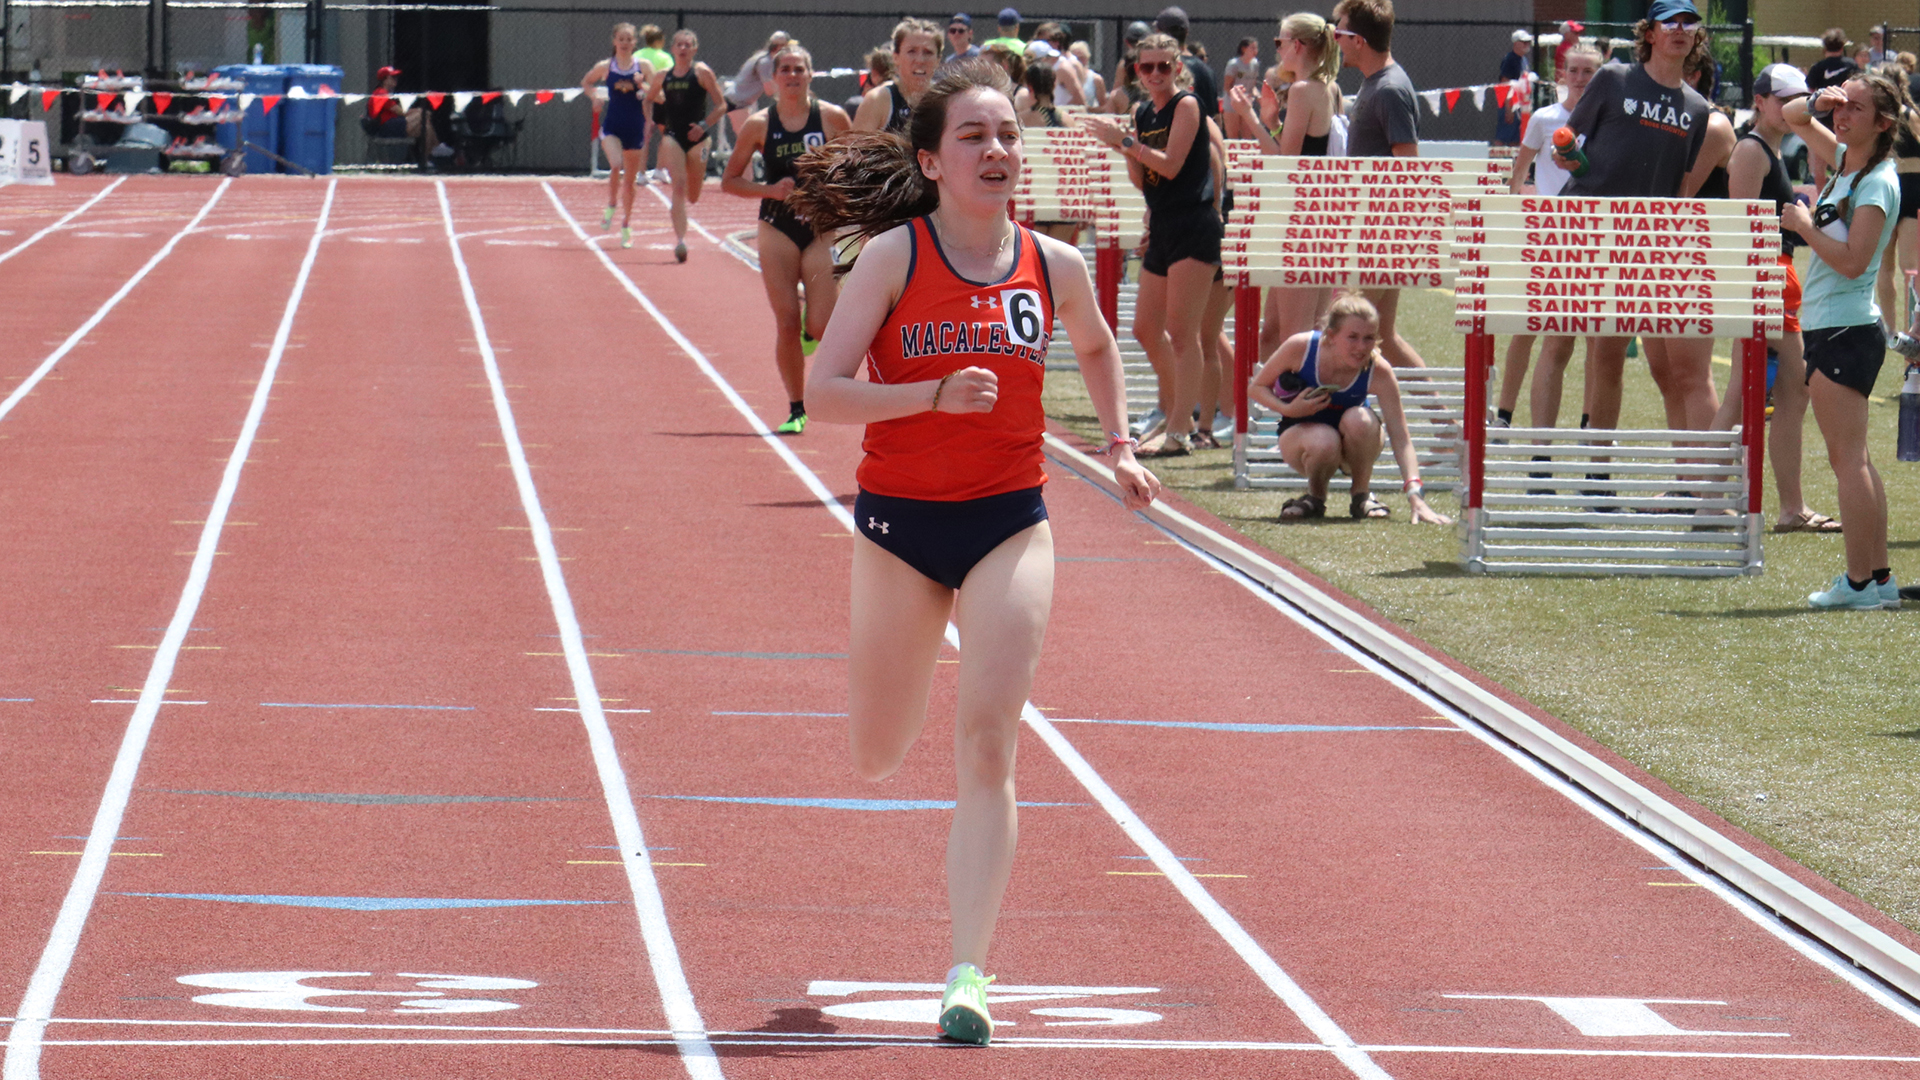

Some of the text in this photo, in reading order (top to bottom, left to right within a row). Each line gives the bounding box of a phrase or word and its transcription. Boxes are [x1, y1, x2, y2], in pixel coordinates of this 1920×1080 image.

[1641, 102, 1691, 130] MAC
[29, 140, 39, 164] 5
[792, 142, 805, 154] OL
[1298, 160, 1454, 172] SAINT MARY'S
[1288, 174, 1443, 185] SAINT MARY'S
[1295, 187, 1451, 198] SAINT MARY'S
[1294, 201, 1450, 212] SAINT MARY'S
[1522, 199, 1706, 215] SAINT MARY'S
[1289, 214, 1445, 226] SAINT MARY'S
[1524, 216, 1710, 232] SAINT MARY'S
[1286, 228, 1442, 240] SAINT MARY'S
[1526, 232, 1712, 248] SAINT MARY'S
[1282, 242, 1438, 254] SAINT MARY'S
[1282, 256, 1440, 268] SAINT MARY'S
[1521, 249, 1707, 265] SAINT MARY'S
[1284, 271, 1442, 286] SAINT MARY'S
[1530, 266, 1716, 281] SAINT MARY'S
[1526, 282, 1712, 298] SAINT MARY'S
[1528, 299, 1714, 314] SAINT MARY'S
[1010, 292, 1040, 344] 6
[1527, 316, 1713, 334] SAINT MARY'S
[901, 322, 1049, 366] MACALES
[176, 971, 539, 1013] 3
